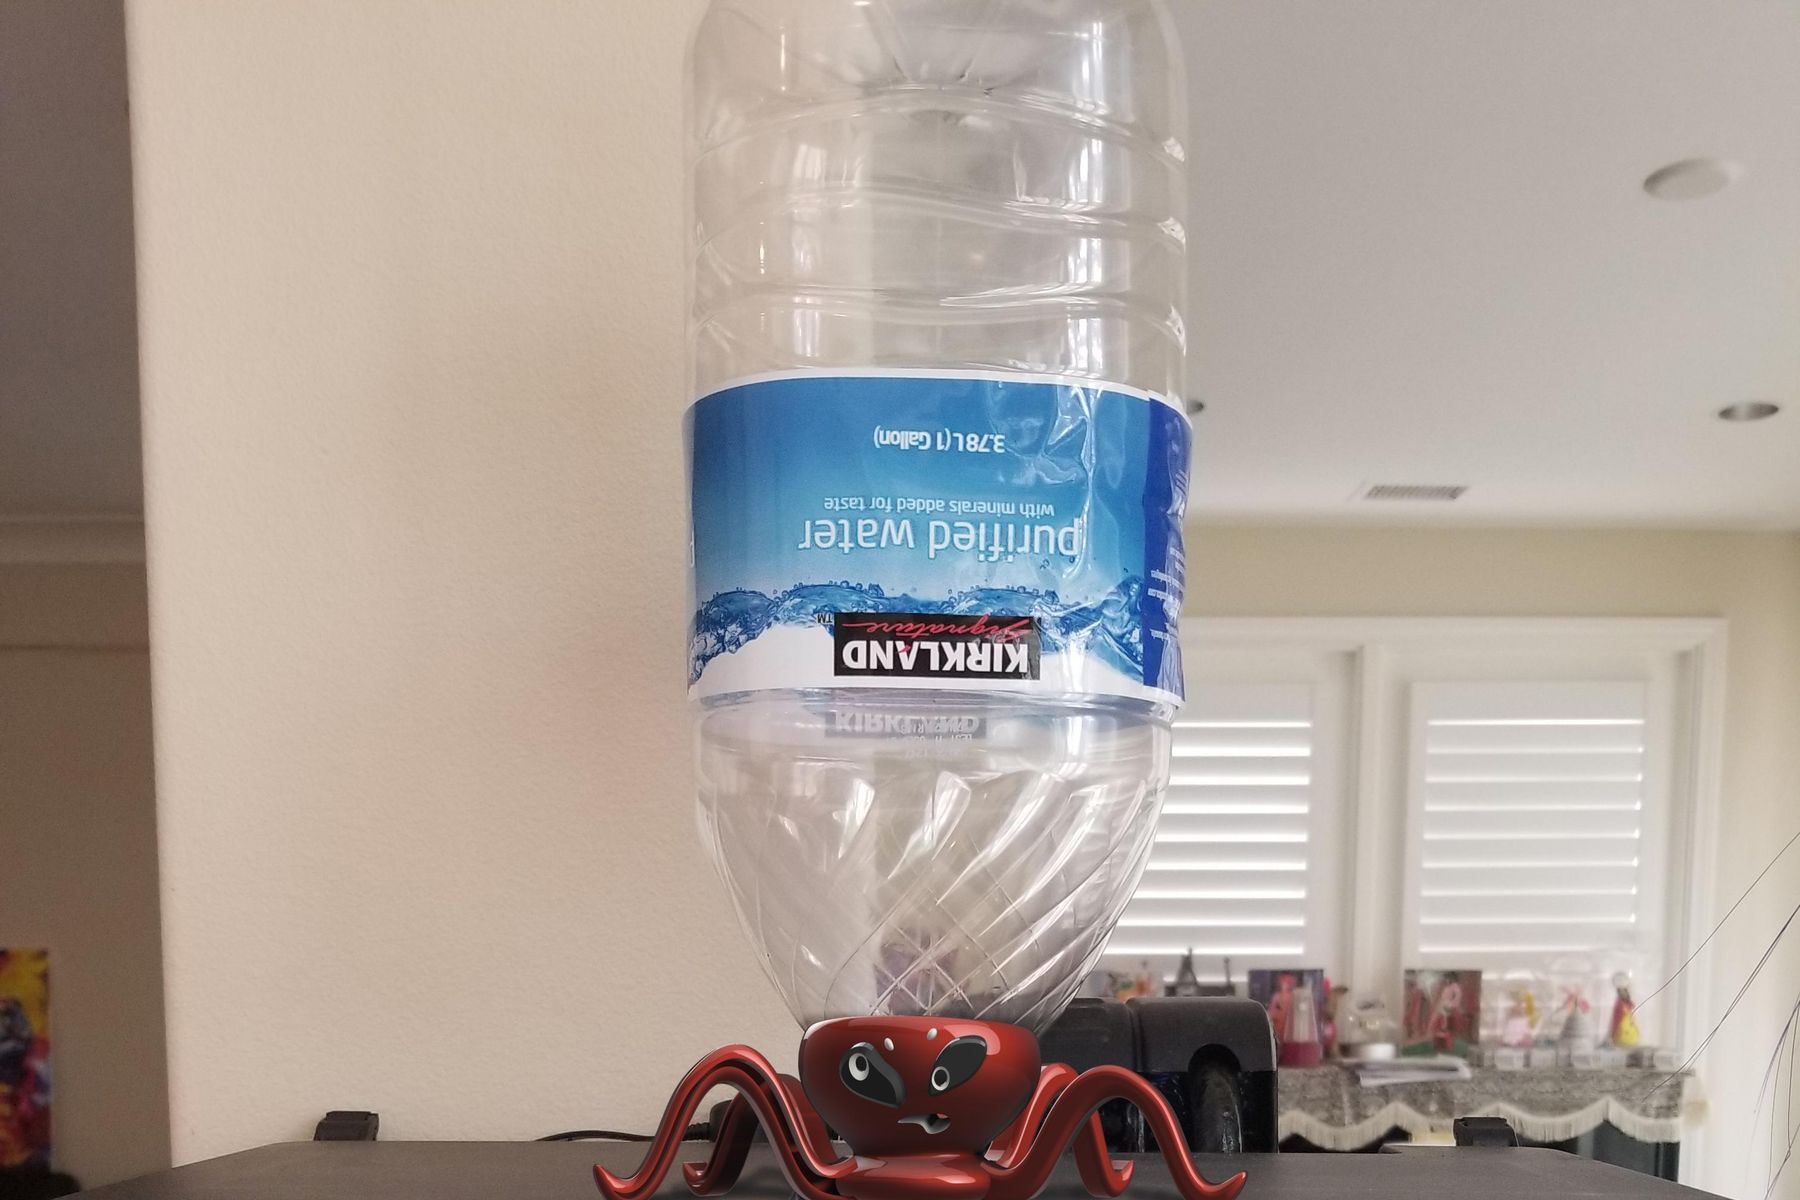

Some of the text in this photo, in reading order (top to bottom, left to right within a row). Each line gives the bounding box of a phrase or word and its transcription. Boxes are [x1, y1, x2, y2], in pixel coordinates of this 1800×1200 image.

[873, 425, 932, 450] Gallon)
[965, 433, 1006, 453] 3.78
[824, 497, 1055, 517] with minerals added for taste
[798, 518, 1080, 563] purified water
[842, 613, 1031, 643] Signature
[842, 640, 1029, 673] KIRKLAND
